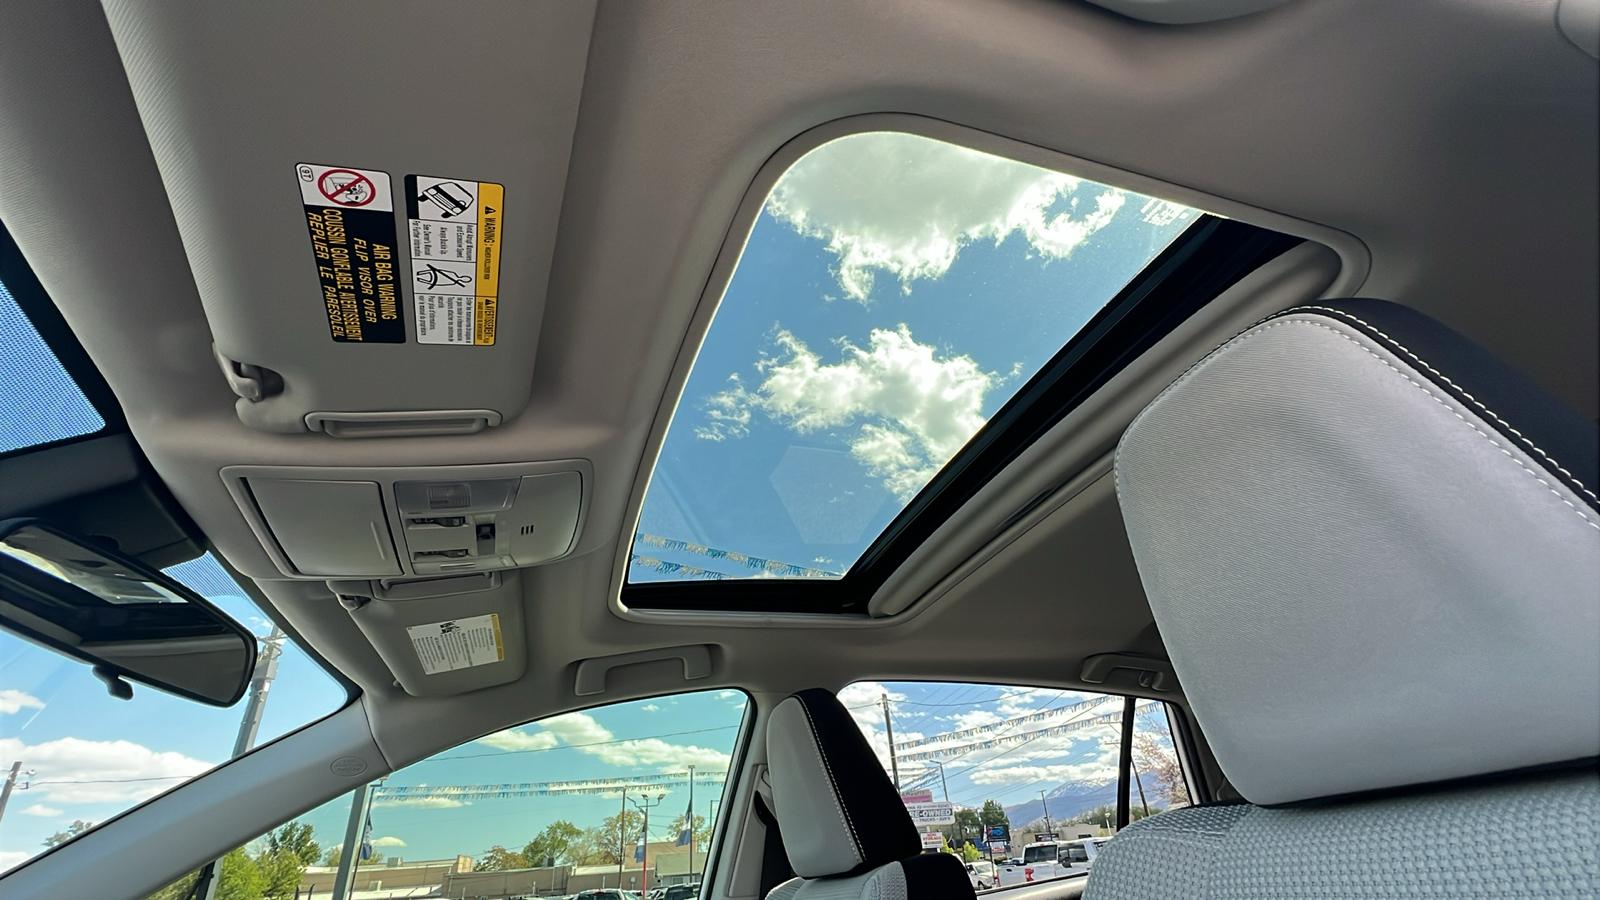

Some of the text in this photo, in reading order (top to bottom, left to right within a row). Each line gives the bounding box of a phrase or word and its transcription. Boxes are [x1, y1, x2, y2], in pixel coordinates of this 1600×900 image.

[302, 169, 311, 178] 9T
[439, 227, 448, 238] Always
[308, 212, 344, 337] REPLIER LE PARESOLEIL
[322, 209, 362, 341] COUSSIN GONFLABLE AVERTISSEMENT
[353, 238, 377, 323] FLIP VISOR OVER
[372, 244, 397, 320] AIR BAG WARNING
[909, 808, 952, 818] RE-OWNED
